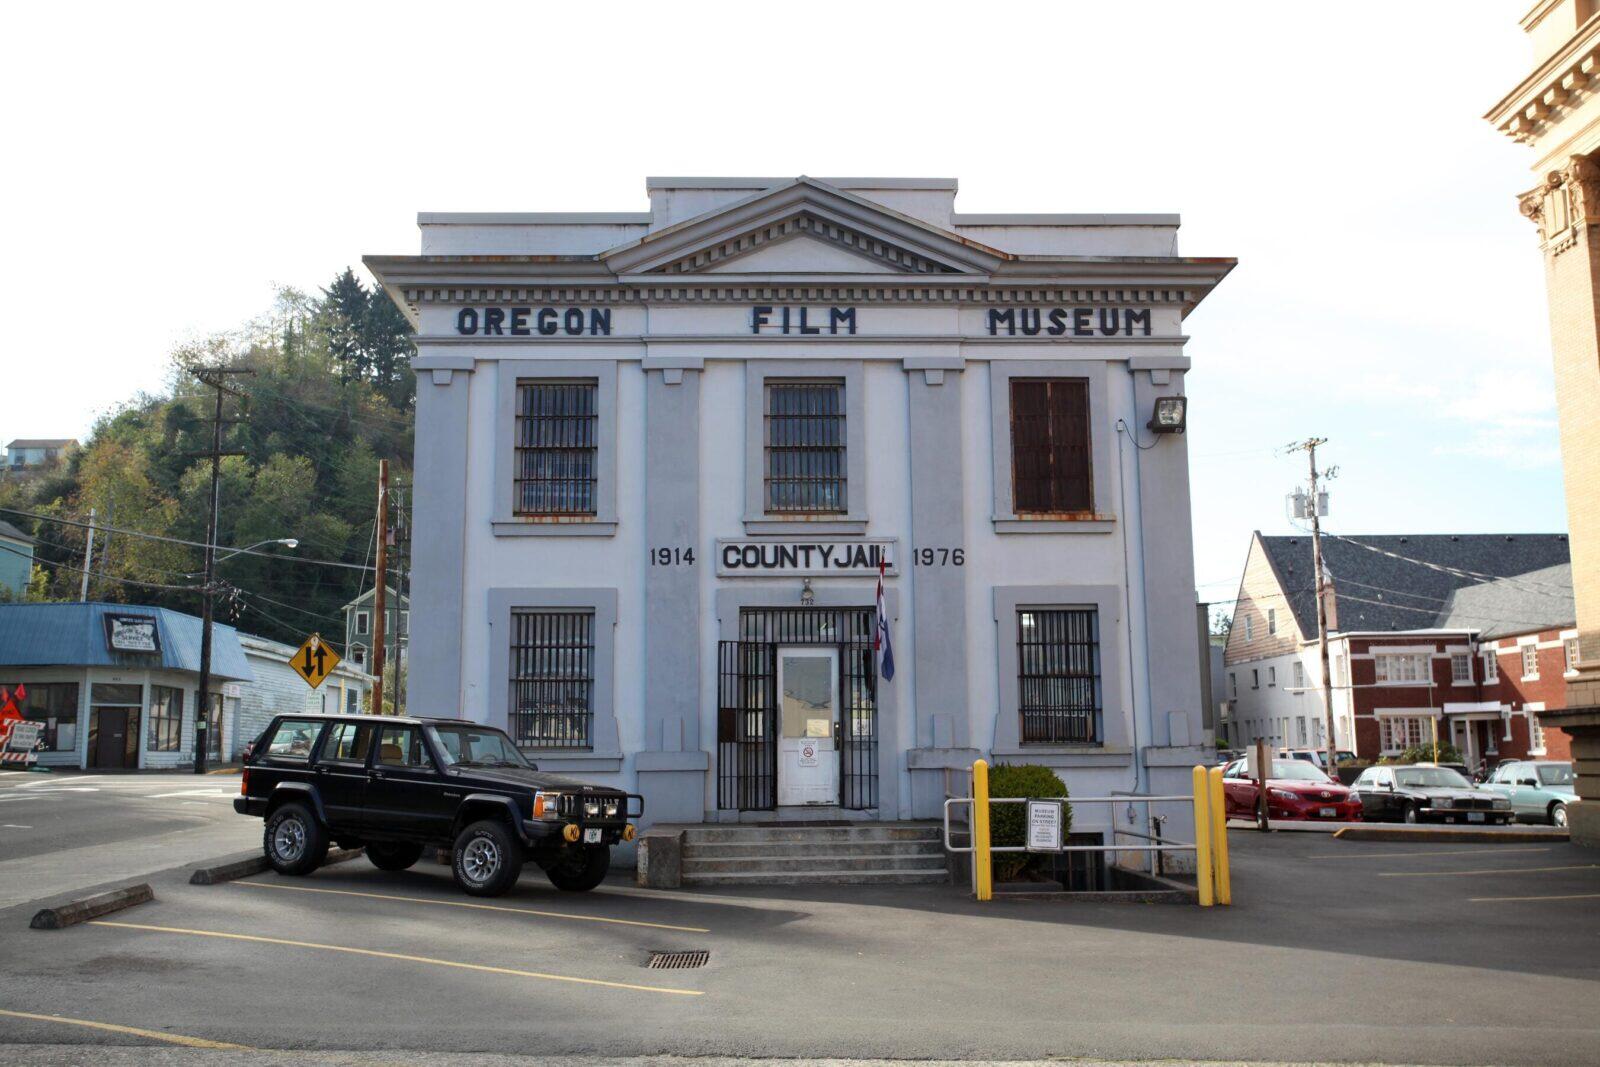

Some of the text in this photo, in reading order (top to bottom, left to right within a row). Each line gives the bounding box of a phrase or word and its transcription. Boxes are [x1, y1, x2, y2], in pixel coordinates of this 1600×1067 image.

[457, 306, 1152, 336] OREGON FILM MUSEUM
[650, 547, 696, 566] 1914
[913, 547, 965, 567] 1976
[800, 598, 813, 606] 732
